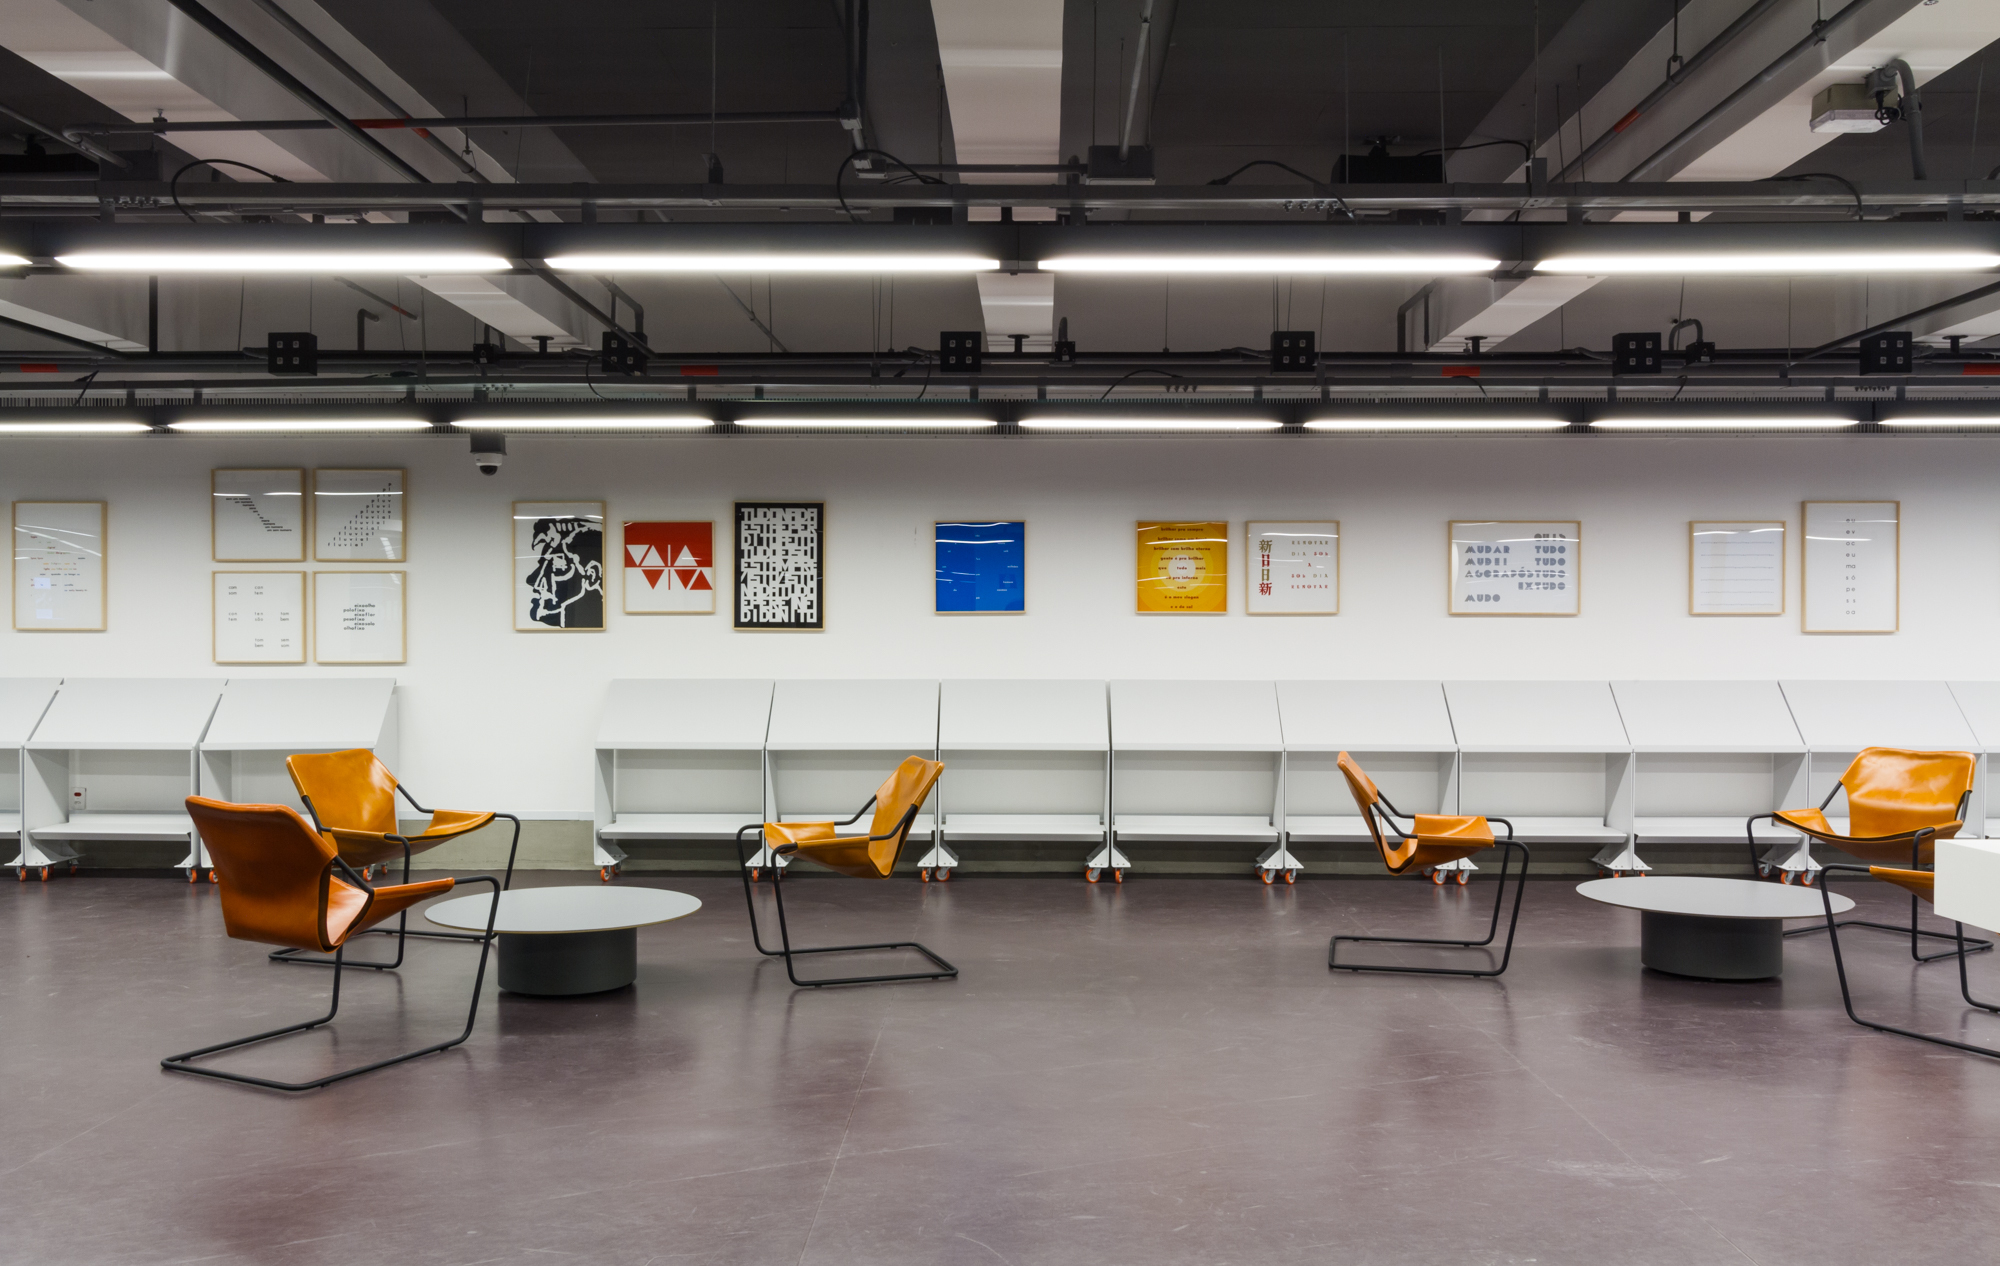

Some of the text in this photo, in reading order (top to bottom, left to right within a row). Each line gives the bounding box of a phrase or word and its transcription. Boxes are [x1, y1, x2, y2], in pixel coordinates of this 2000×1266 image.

[1465, 545, 1566, 554] MUDAR TUDO
[1465, 558, 1566, 566] MUDEI TUDO
[1259, 539, 1272, 596] 新日日新
[1518, 582, 1566, 590] EXTUDO
[1464, 594, 1501, 602] MUDO
